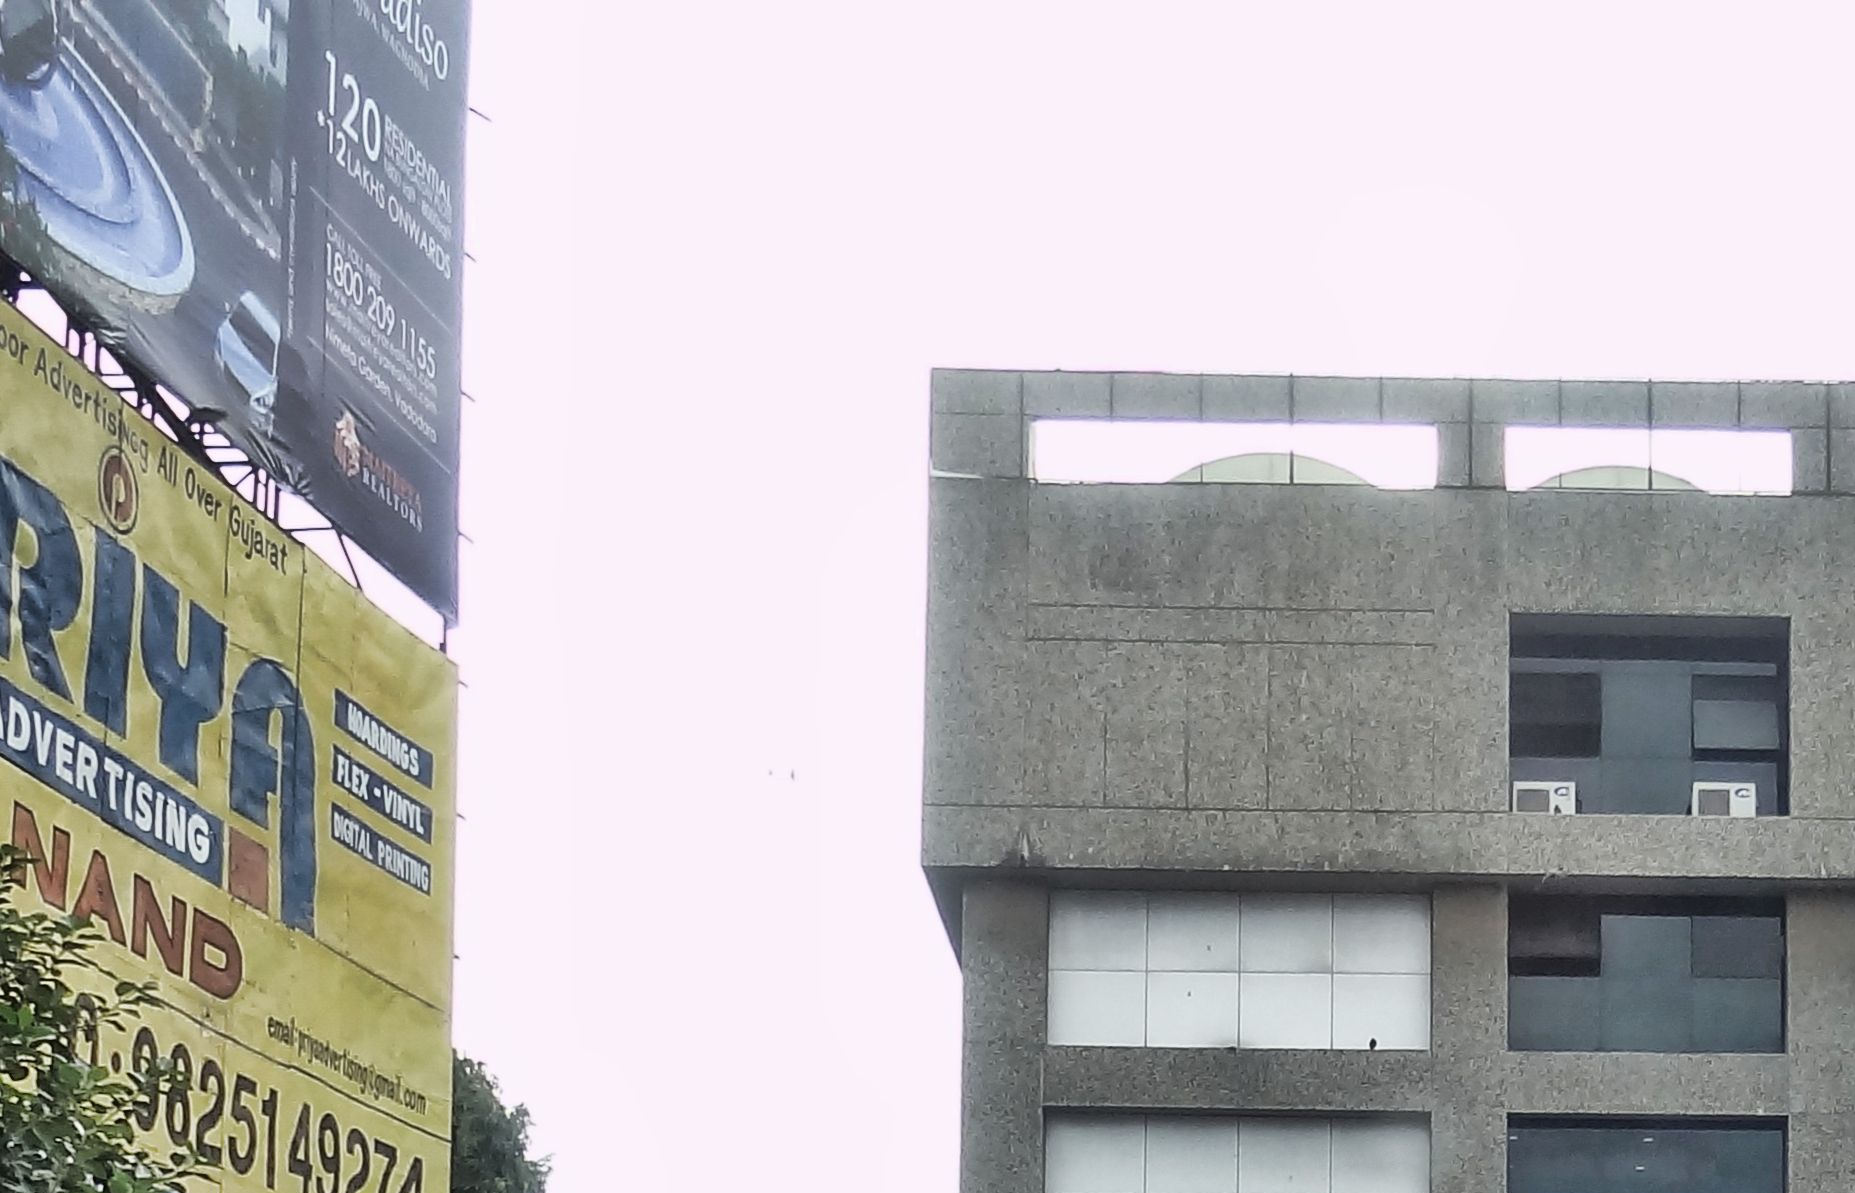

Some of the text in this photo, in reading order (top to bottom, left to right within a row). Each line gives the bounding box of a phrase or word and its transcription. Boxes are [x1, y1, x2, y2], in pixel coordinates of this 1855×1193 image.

[325, 50, 380, 162] 120
[384, 113, 452, 207] RESIDENTIAL
[387, 195, 452, 280] ONWARDS
[326, 242, 363, 306] 1800
[367, 285, 396, 336] 209
[401, 318, 437, 379] 1155
[157, 445, 289, 576] All Over Gujarat
[362, 467, 423, 533] REALTORS
[0, 693, 211, 866] DVERTISING
[347, 702, 420, 777] HOARDINGS
[336, 754, 425, 835] FLEX VINYL
[333, 816, 429, 892] DIGITAL PRINTING
